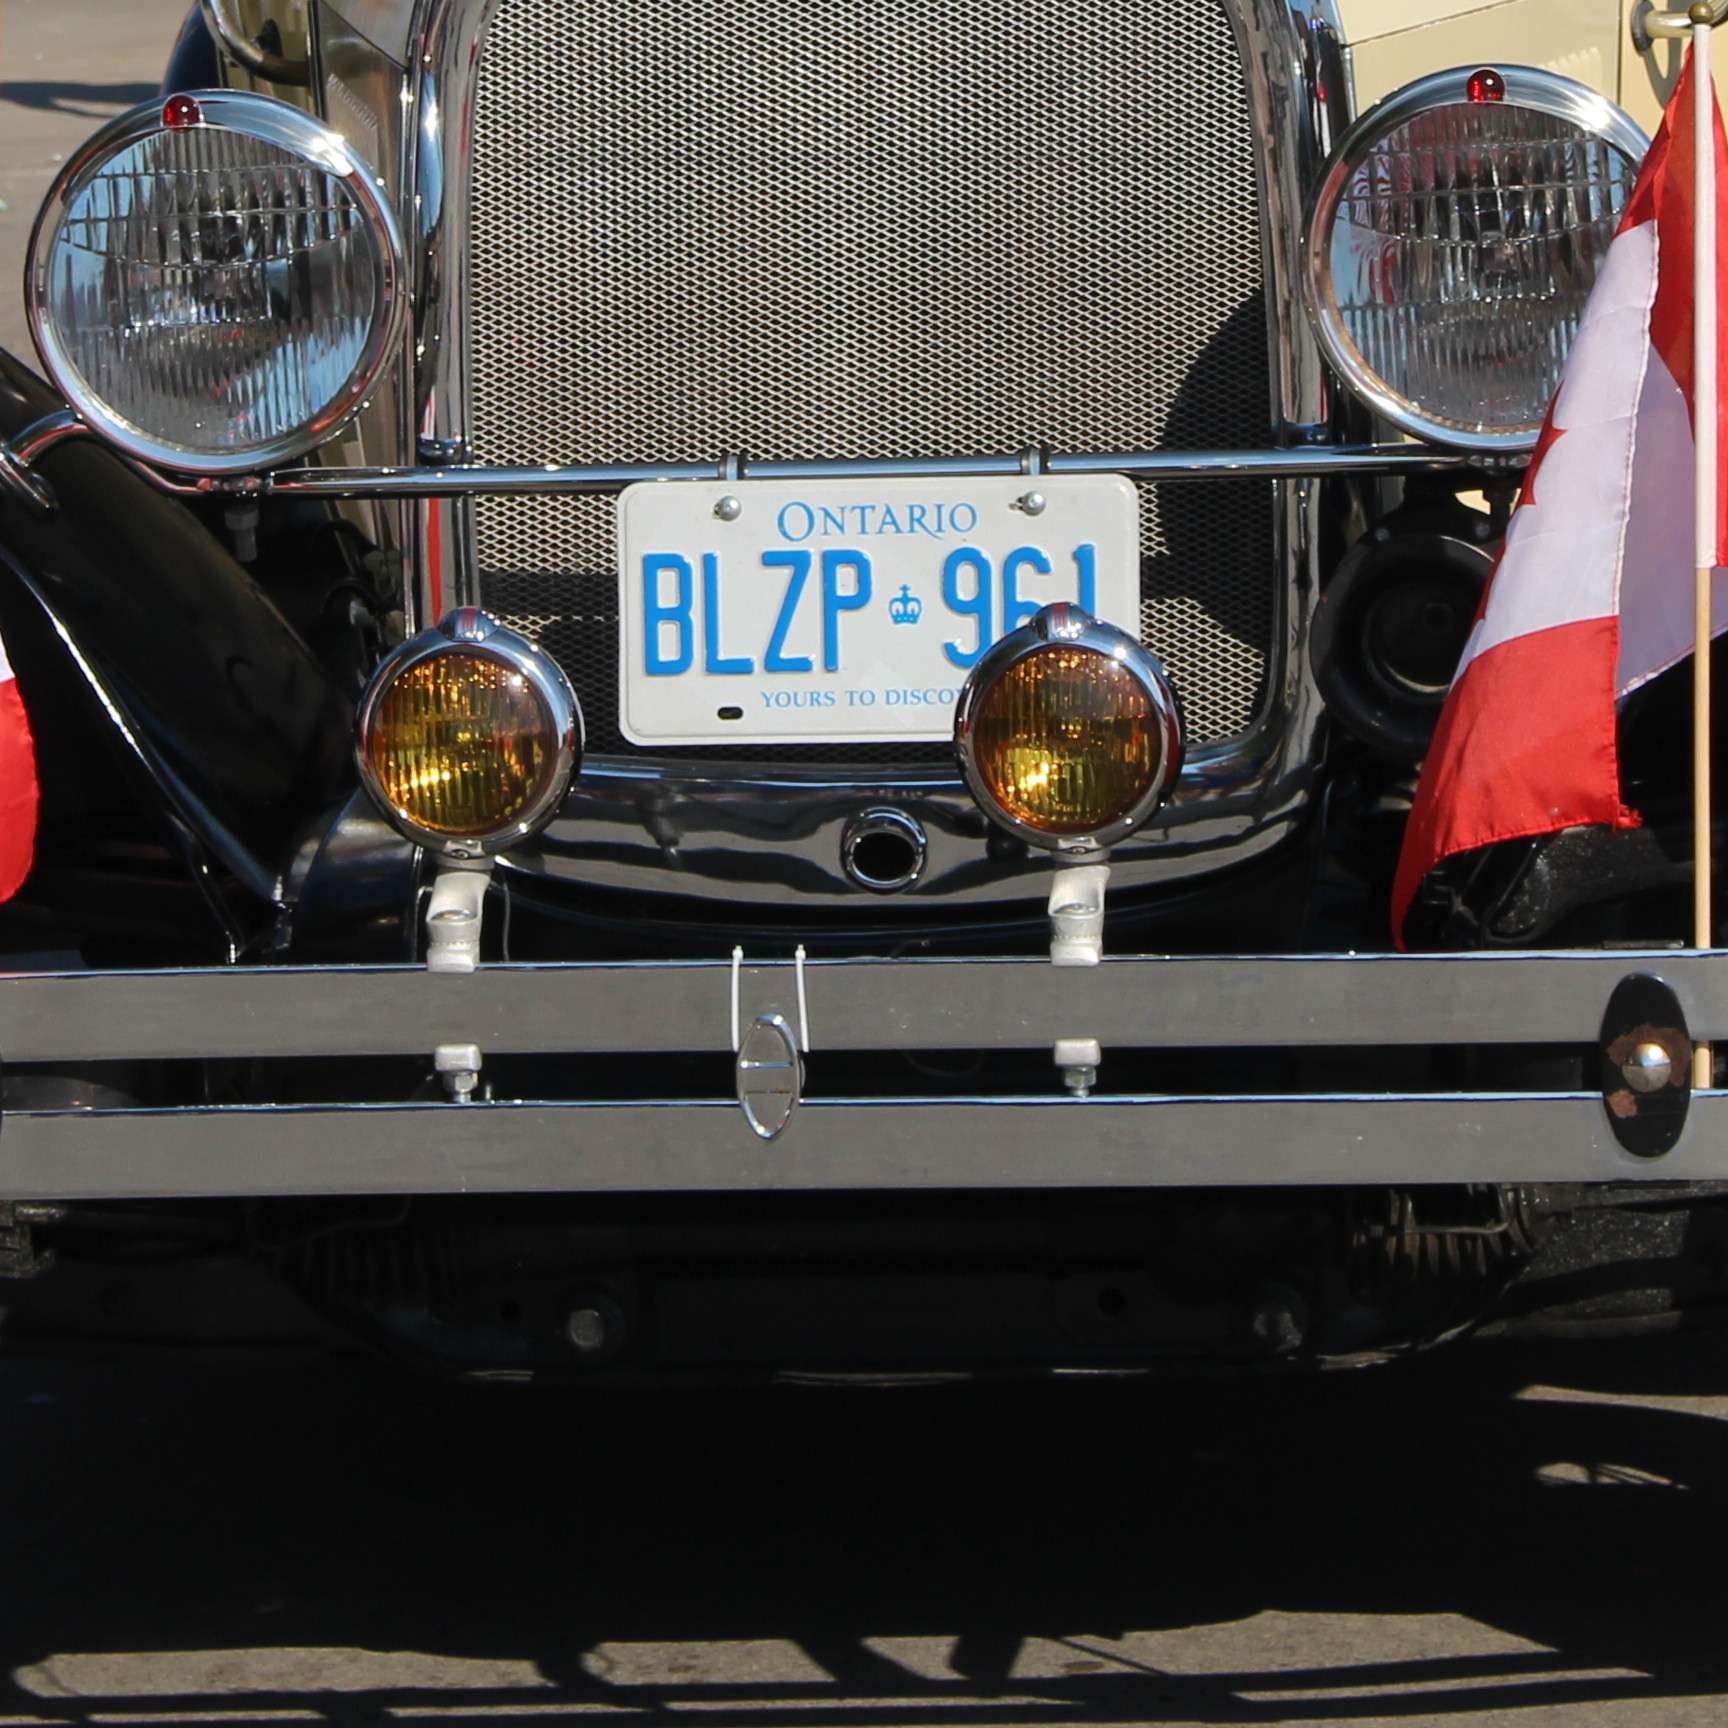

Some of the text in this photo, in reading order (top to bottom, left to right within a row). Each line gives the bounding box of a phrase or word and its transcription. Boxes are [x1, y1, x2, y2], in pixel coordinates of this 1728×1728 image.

[777, 501, 978, 543] ONTARIO
[642, 543, 1097, 676] BLZP 961
[760, 687, 961, 710] YOURS TO DISCO
